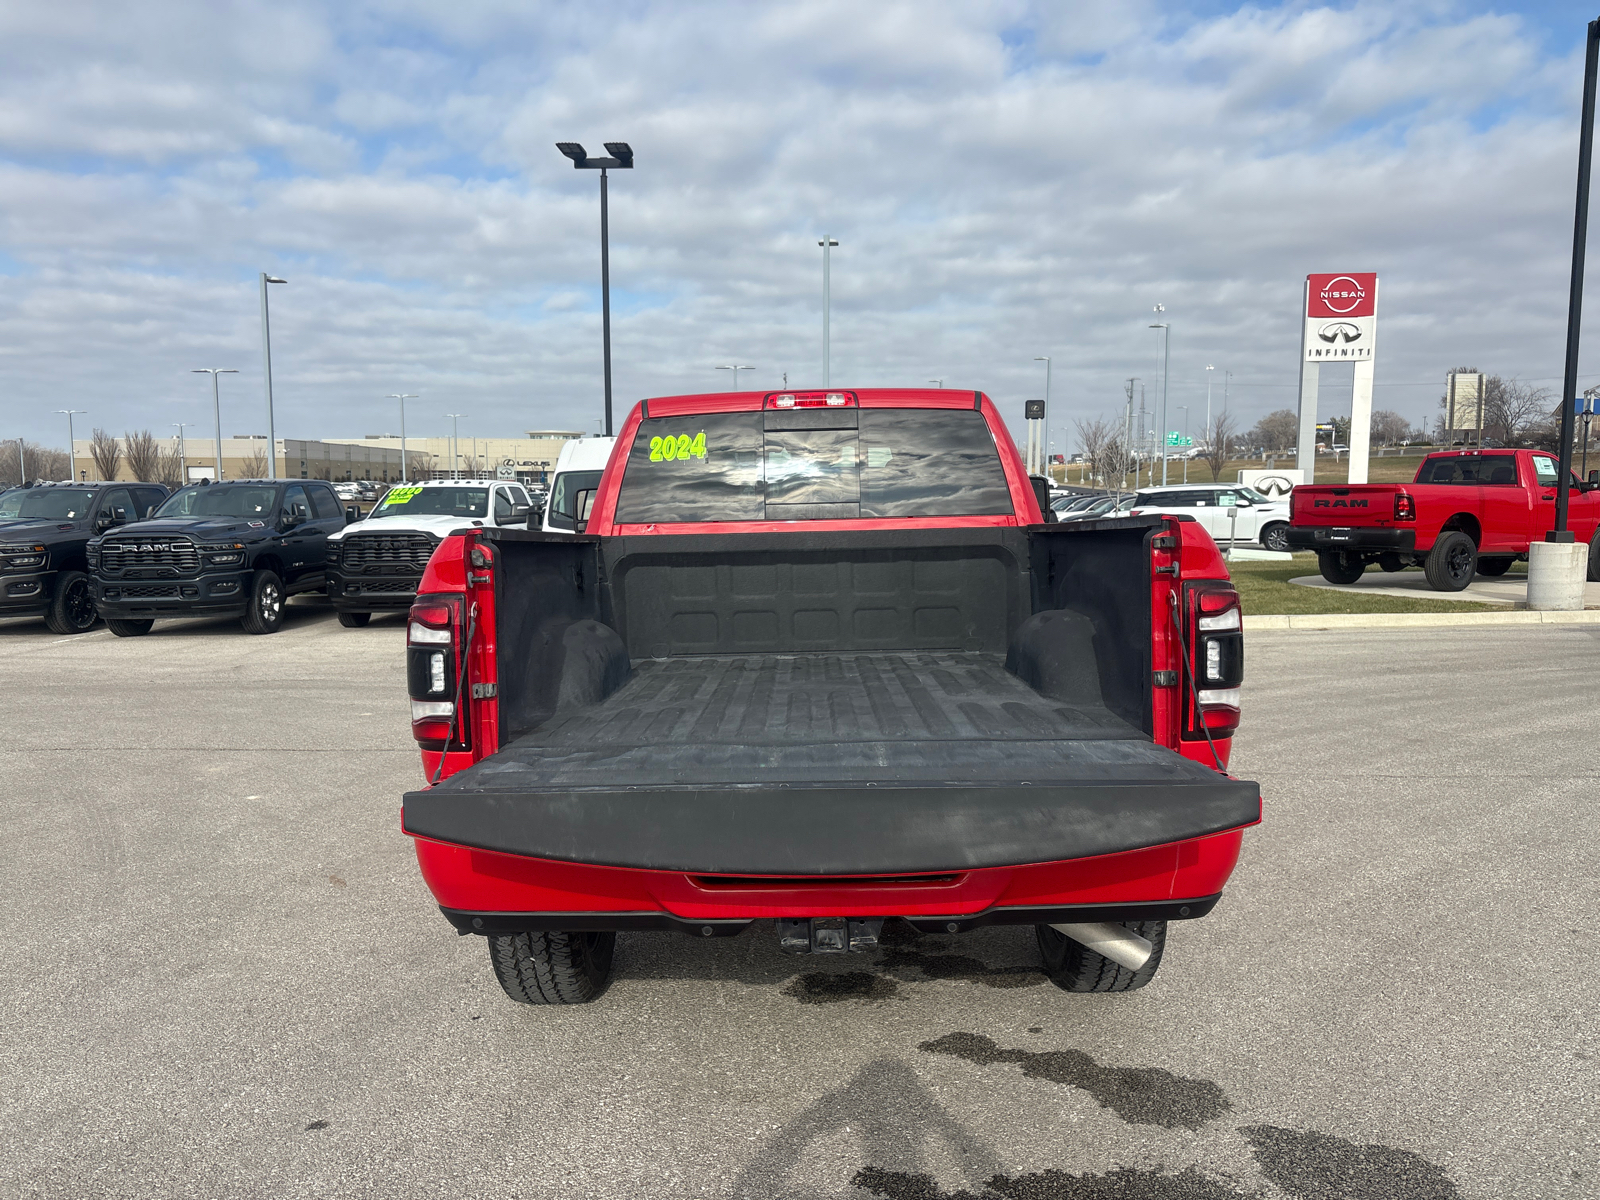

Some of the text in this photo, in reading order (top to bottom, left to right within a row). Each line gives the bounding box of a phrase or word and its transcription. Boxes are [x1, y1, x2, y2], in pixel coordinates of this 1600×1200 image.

[1308, 348, 1371, 357] INFINITI
[649, 432, 707, 462] 2024
[1314, 499, 1369, 508] RAM
[122, 544, 169, 552] RAM
